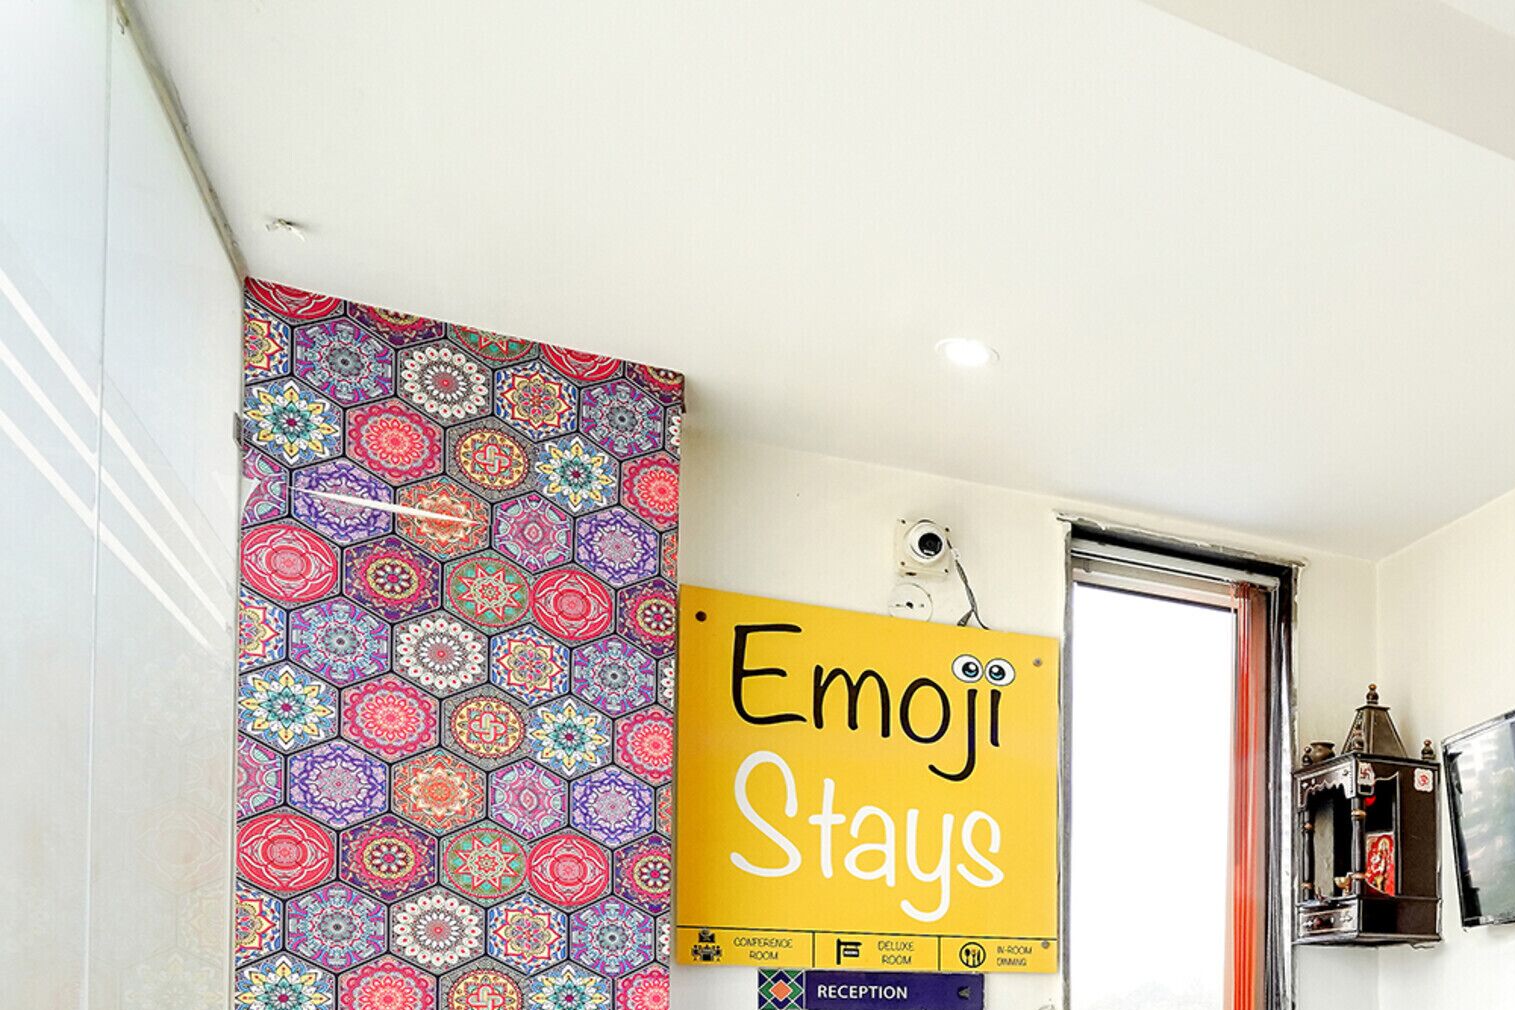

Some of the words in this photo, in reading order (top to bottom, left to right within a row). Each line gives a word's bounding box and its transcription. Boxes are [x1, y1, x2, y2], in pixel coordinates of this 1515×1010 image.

[731, 623, 1003, 782] Emoji
[730, 750, 1004, 923] Stays
[733, 936, 793, 950] CONFERENCE
[877, 939, 914, 952] DELUXE
[749, 950, 779, 961] ROOM
[997, 945, 1033, 955] IN-ROOM
[881, 953, 912, 965] ROOM
[817, 984, 909, 1000] RECEPTION
